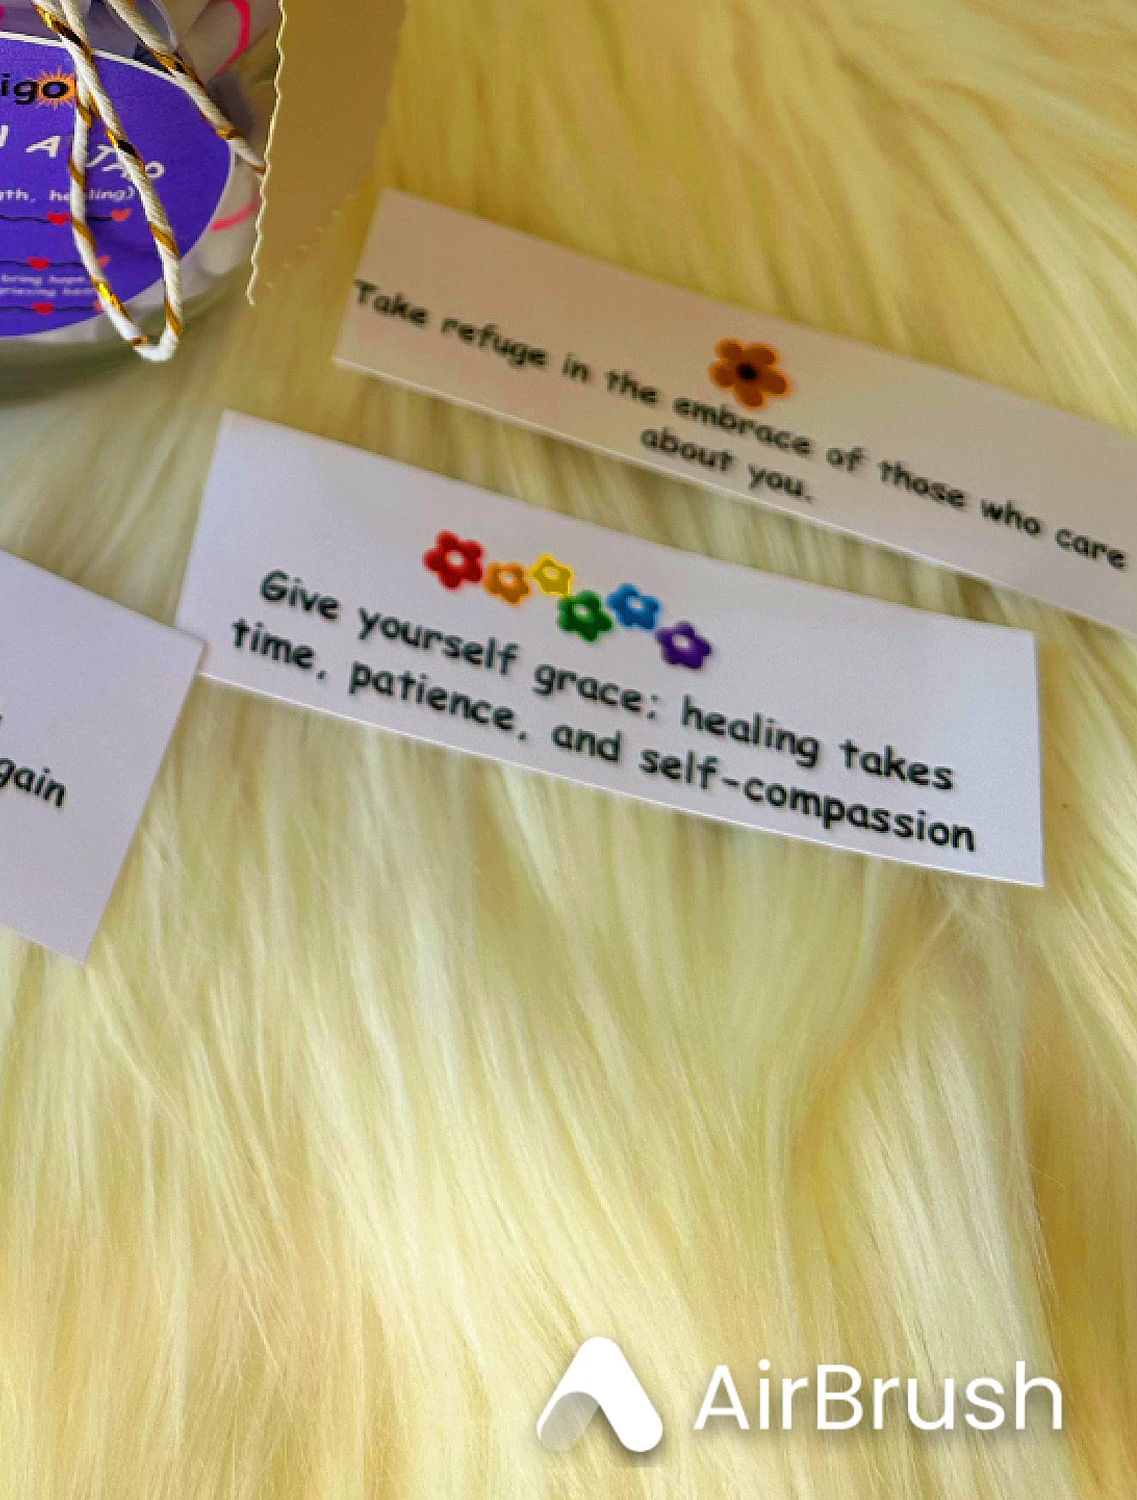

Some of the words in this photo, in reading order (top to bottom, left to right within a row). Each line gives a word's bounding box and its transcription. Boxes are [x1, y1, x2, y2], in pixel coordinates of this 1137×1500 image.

[25, 135, 61, 158] A
[355, 279, 429, 326] Take
[441, 317, 549, 368] refuge
[562, 353, 590, 382] in
[605, 370, 659, 405] the
[673, 397, 812, 455] embrace
[826, 447, 864, 473] of
[877, 460, 966, 508] those
[979, 498, 1042, 536] who
[1056, 528, 1127, 570] care
[640, 427, 736, 472] about
[261, 569, 340, 621] Give
[359, 607, 519, 675] yourself
[681, 694, 820, 768] healing
[839, 739, 954, 790] takes
[553, 724, 622, 763] and
[639, 749, 976, 852] self-compassion
